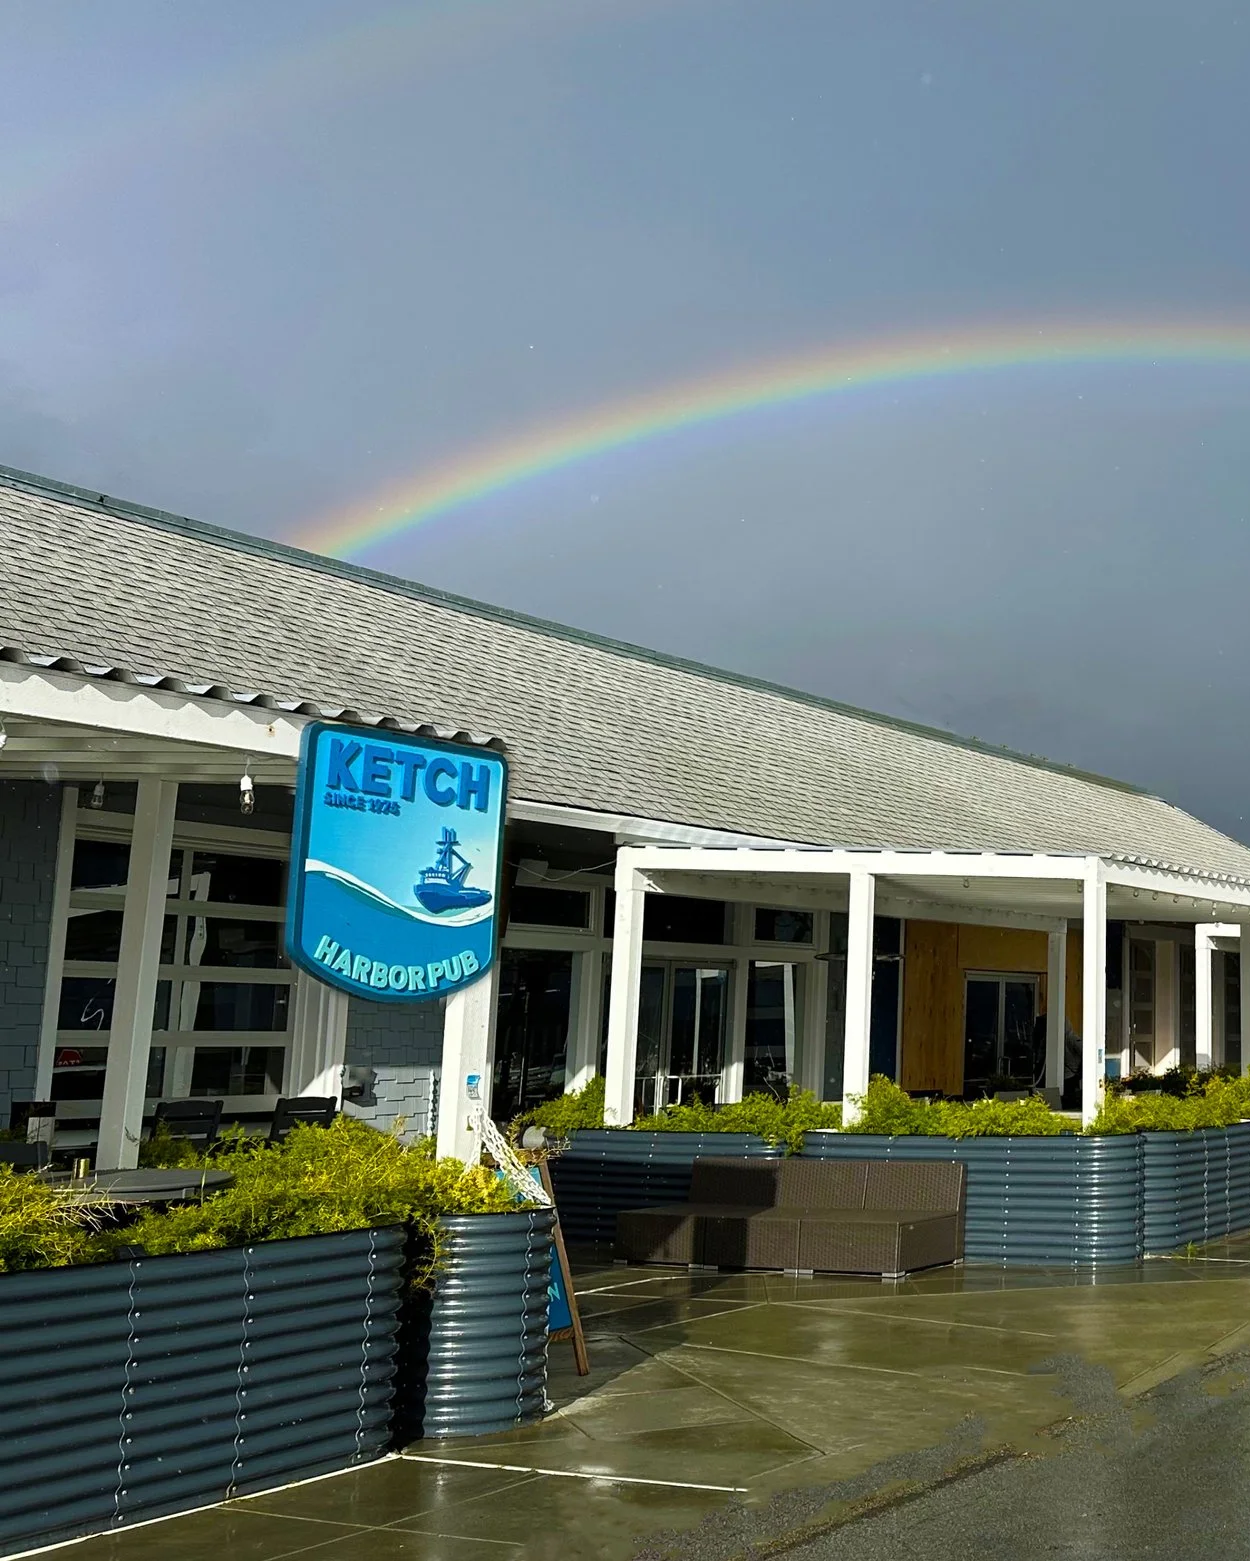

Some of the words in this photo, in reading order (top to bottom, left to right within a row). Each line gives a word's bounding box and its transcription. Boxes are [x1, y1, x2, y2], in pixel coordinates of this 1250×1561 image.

[323, 791, 366, 812] SINCE
[326, 738, 491, 813] KETCH
[313, 934, 426, 991] HARBOR
[427, 950, 480, 988] PUB
